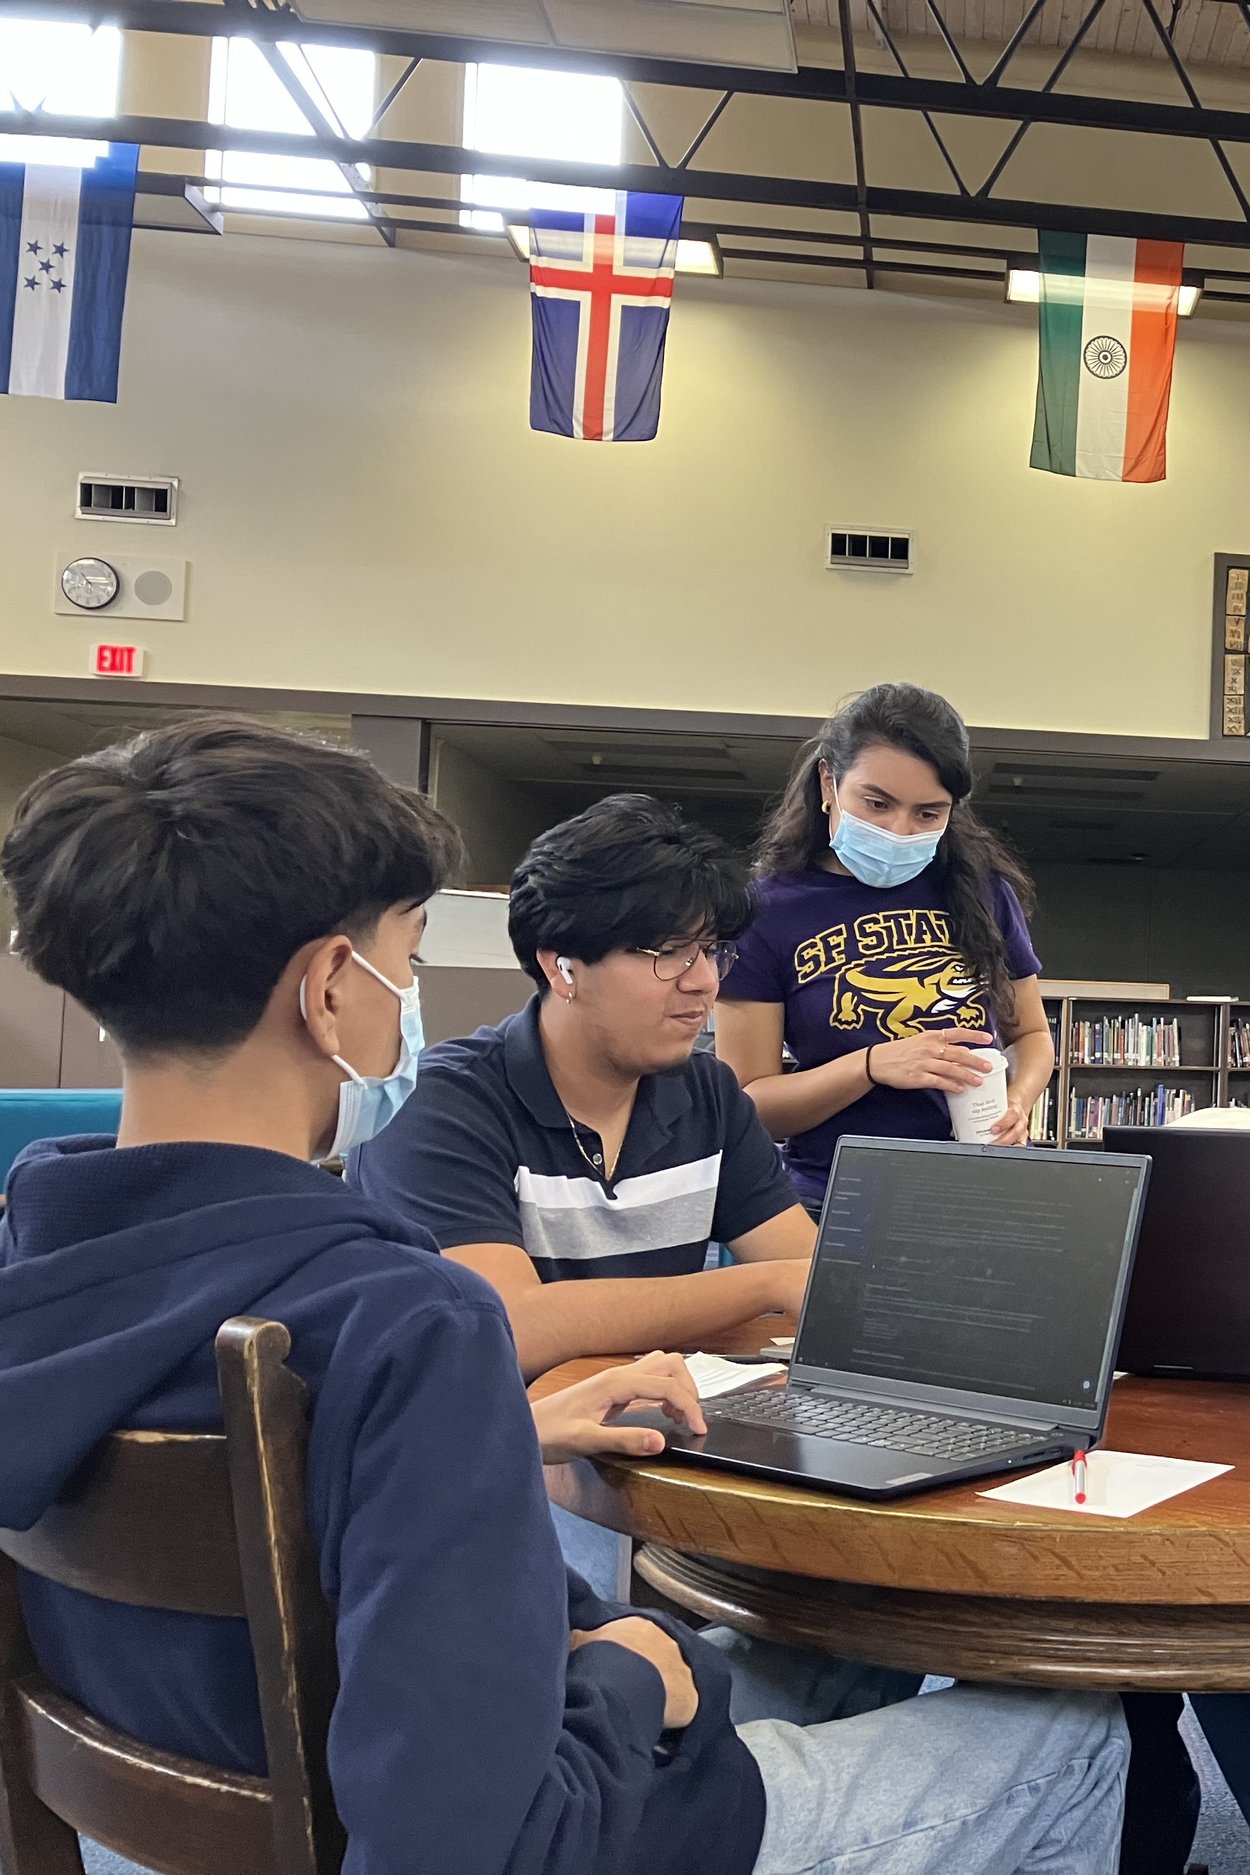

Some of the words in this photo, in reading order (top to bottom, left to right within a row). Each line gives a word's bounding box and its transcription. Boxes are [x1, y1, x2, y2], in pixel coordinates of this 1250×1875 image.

[97, 645, 136, 673] EXIT
[795, 923, 847, 984] SF
[853, 909, 951, 955] STAT
